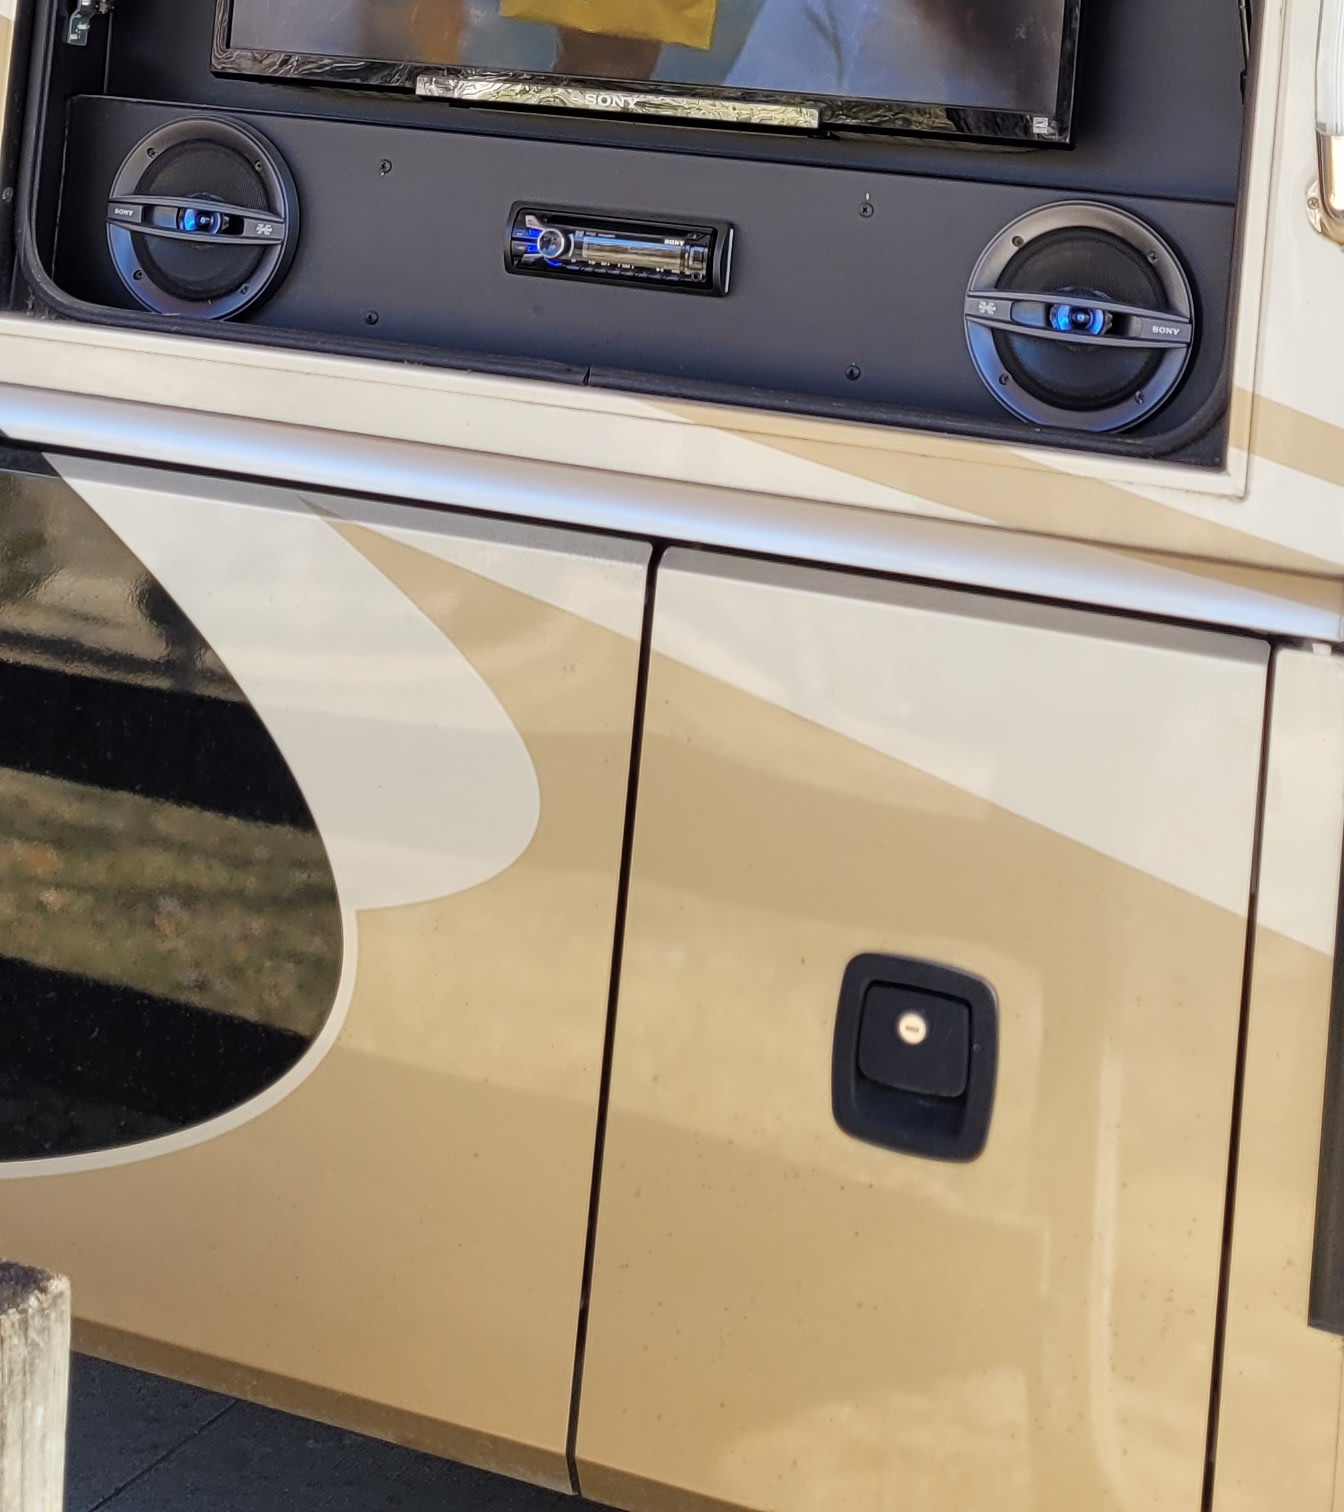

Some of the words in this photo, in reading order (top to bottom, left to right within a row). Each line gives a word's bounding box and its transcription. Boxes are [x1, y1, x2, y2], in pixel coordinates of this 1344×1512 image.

[585, 93, 637, 108] SONY
[114, 208, 134, 216] SONY
[664, 238, 685, 246] SONY
[1152, 325, 1180, 336] SONY
